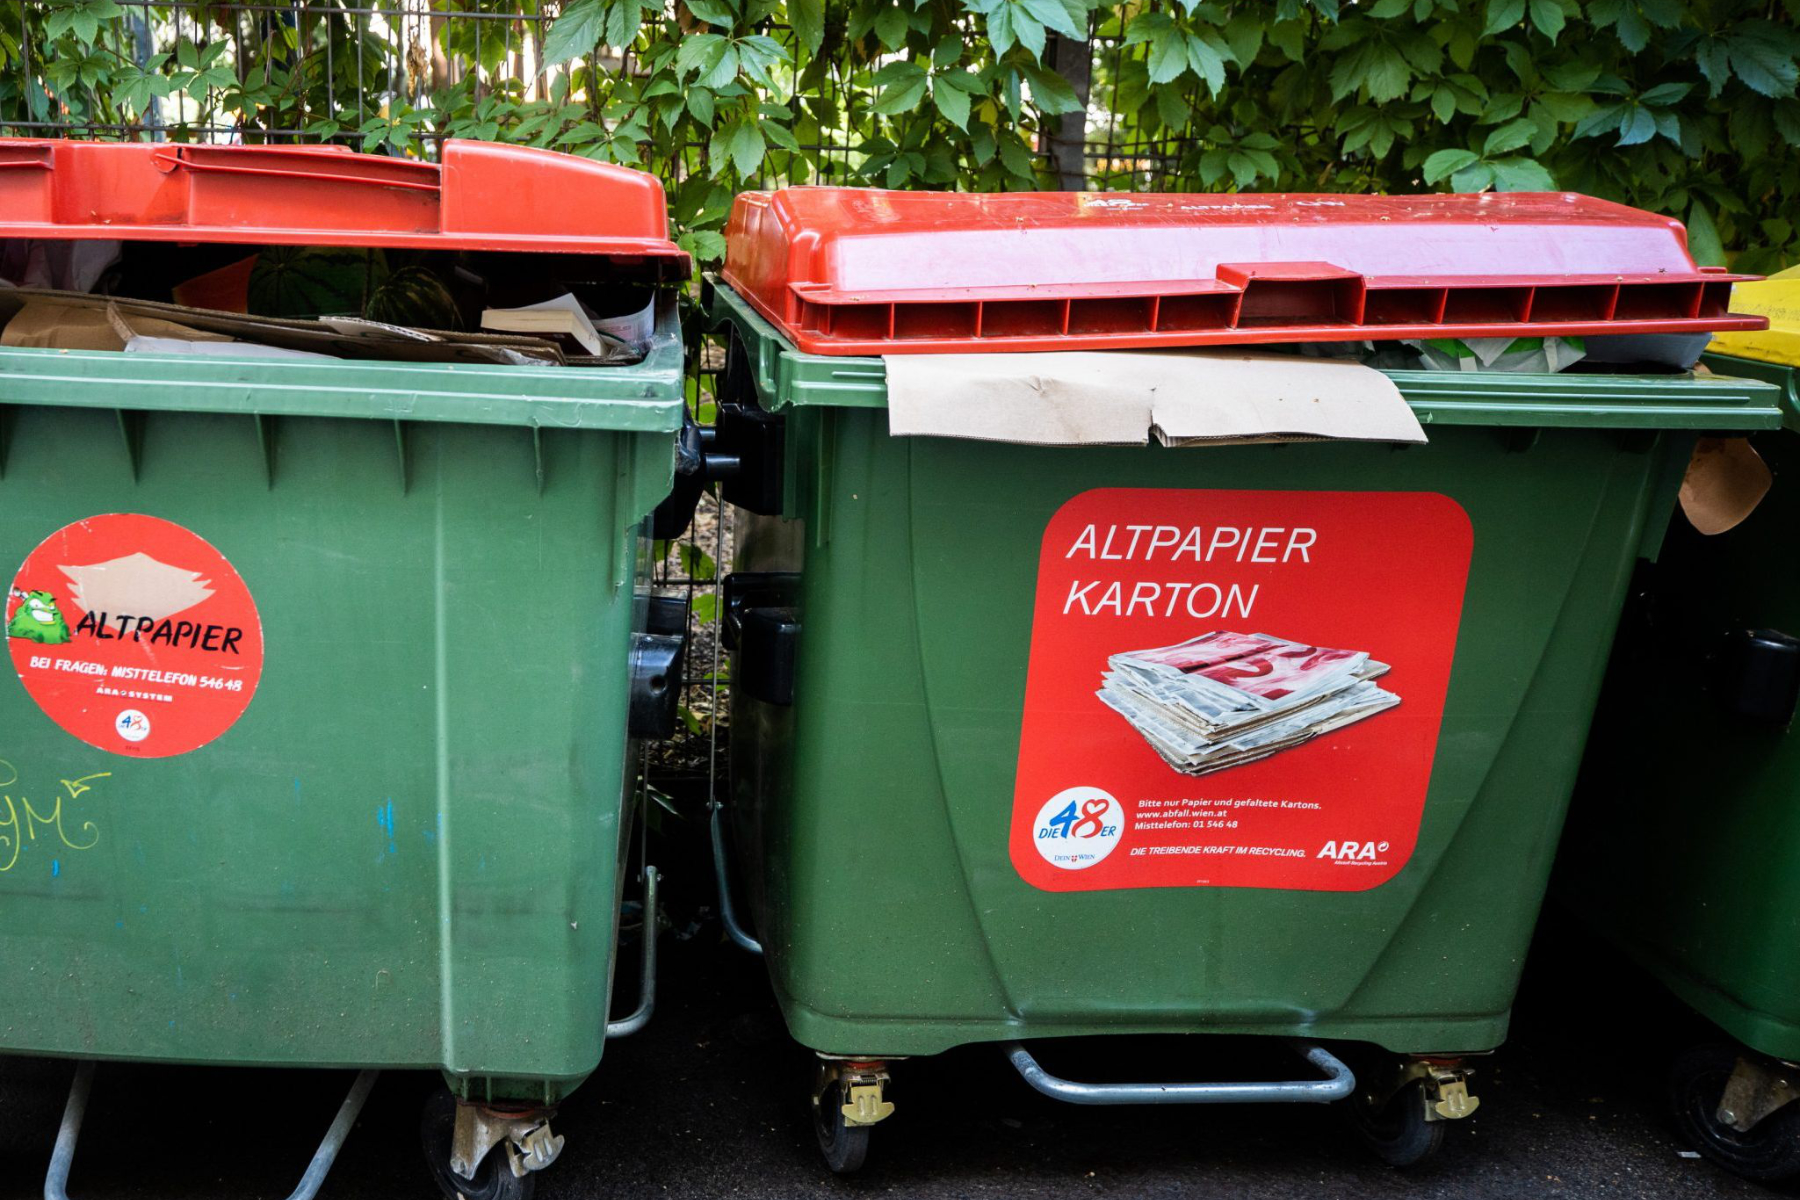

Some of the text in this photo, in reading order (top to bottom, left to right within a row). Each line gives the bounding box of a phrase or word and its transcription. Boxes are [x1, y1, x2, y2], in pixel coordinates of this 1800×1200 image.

[1065, 524, 1318, 563] ALTPAPIER
[1062, 580, 1259, 618] KARTON
[76, 610, 243, 654] ALTPAPIER
[30, 655, 51, 669] BEI
[54, 659, 108, 677] FRAGEN:
[111, 666, 198, 686] MISTTELEFON
[1138, 799, 1162, 808] Bitte
[1181, 798, 1212, 808] Papier
[1213, 798, 1232, 807] und
[1234, 798, 1279, 809] gefaltete
[1280, 799, 1322, 810] Kartons.
[1136, 809, 1228, 819] www.abfall.wien.at
[1038, 827, 1061, 839] DIE
[1134, 820, 1239, 830] Misttelefon: 01 546 48
[1130, 846, 1306, 858] DIE TREIBENDE KRAFT IM RECYCLING.
[1316, 840, 1377, 860] ARA
